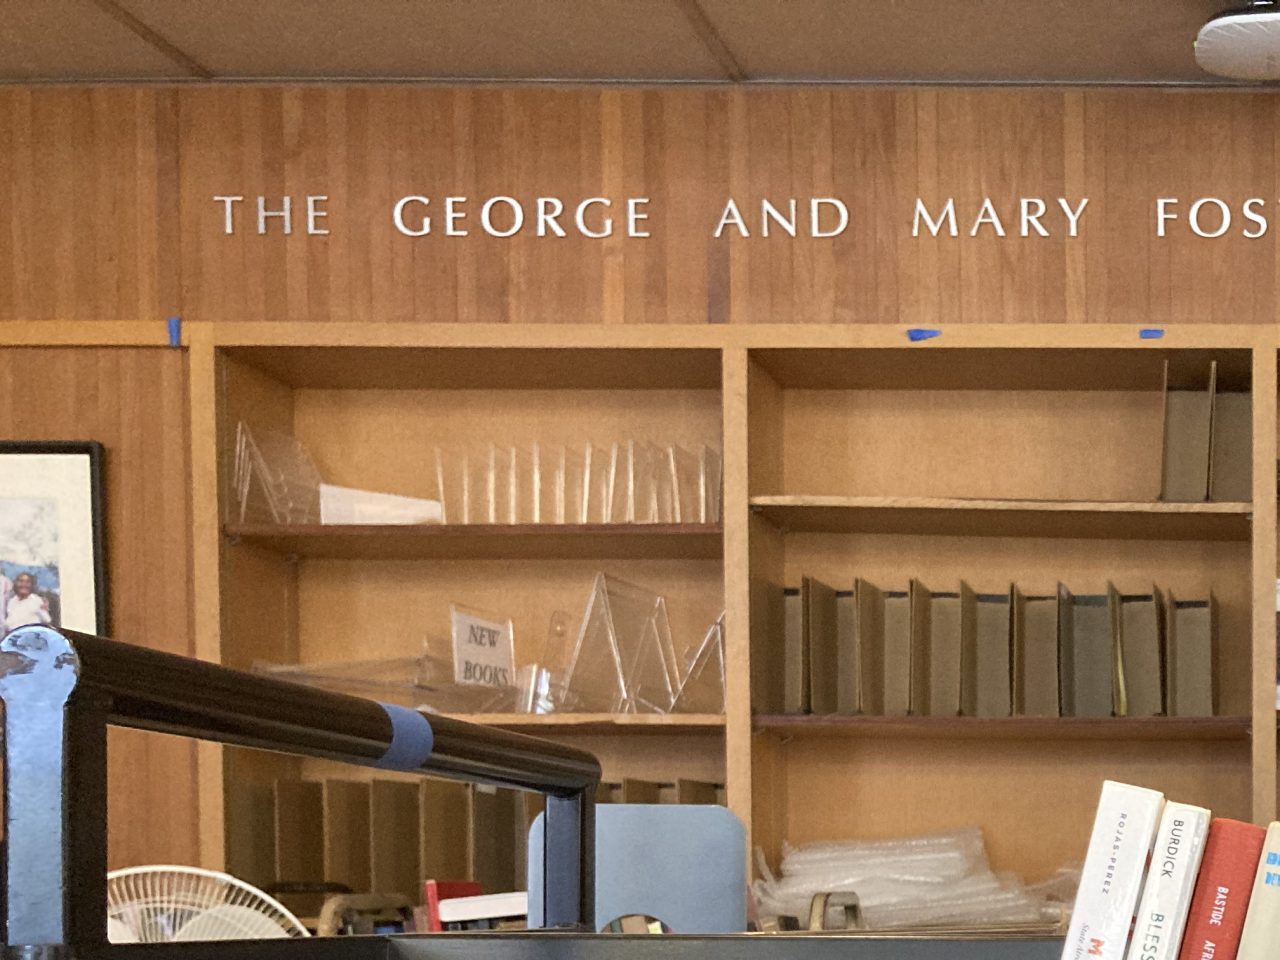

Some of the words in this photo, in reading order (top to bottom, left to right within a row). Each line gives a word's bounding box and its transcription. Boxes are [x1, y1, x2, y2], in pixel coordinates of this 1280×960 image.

[213, 196, 330, 235] THE
[393, 196, 650, 238] GEORGE
[713, 197, 850, 238] AND
[912, 198, 1089, 238] MARY
[468, 624, 500, 648] NEW
[463, 661, 509, 687] BOOKS
[1161, 819, 1185, 878] BURDICK
[1209, 886, 1229, 927] BASTIDE
